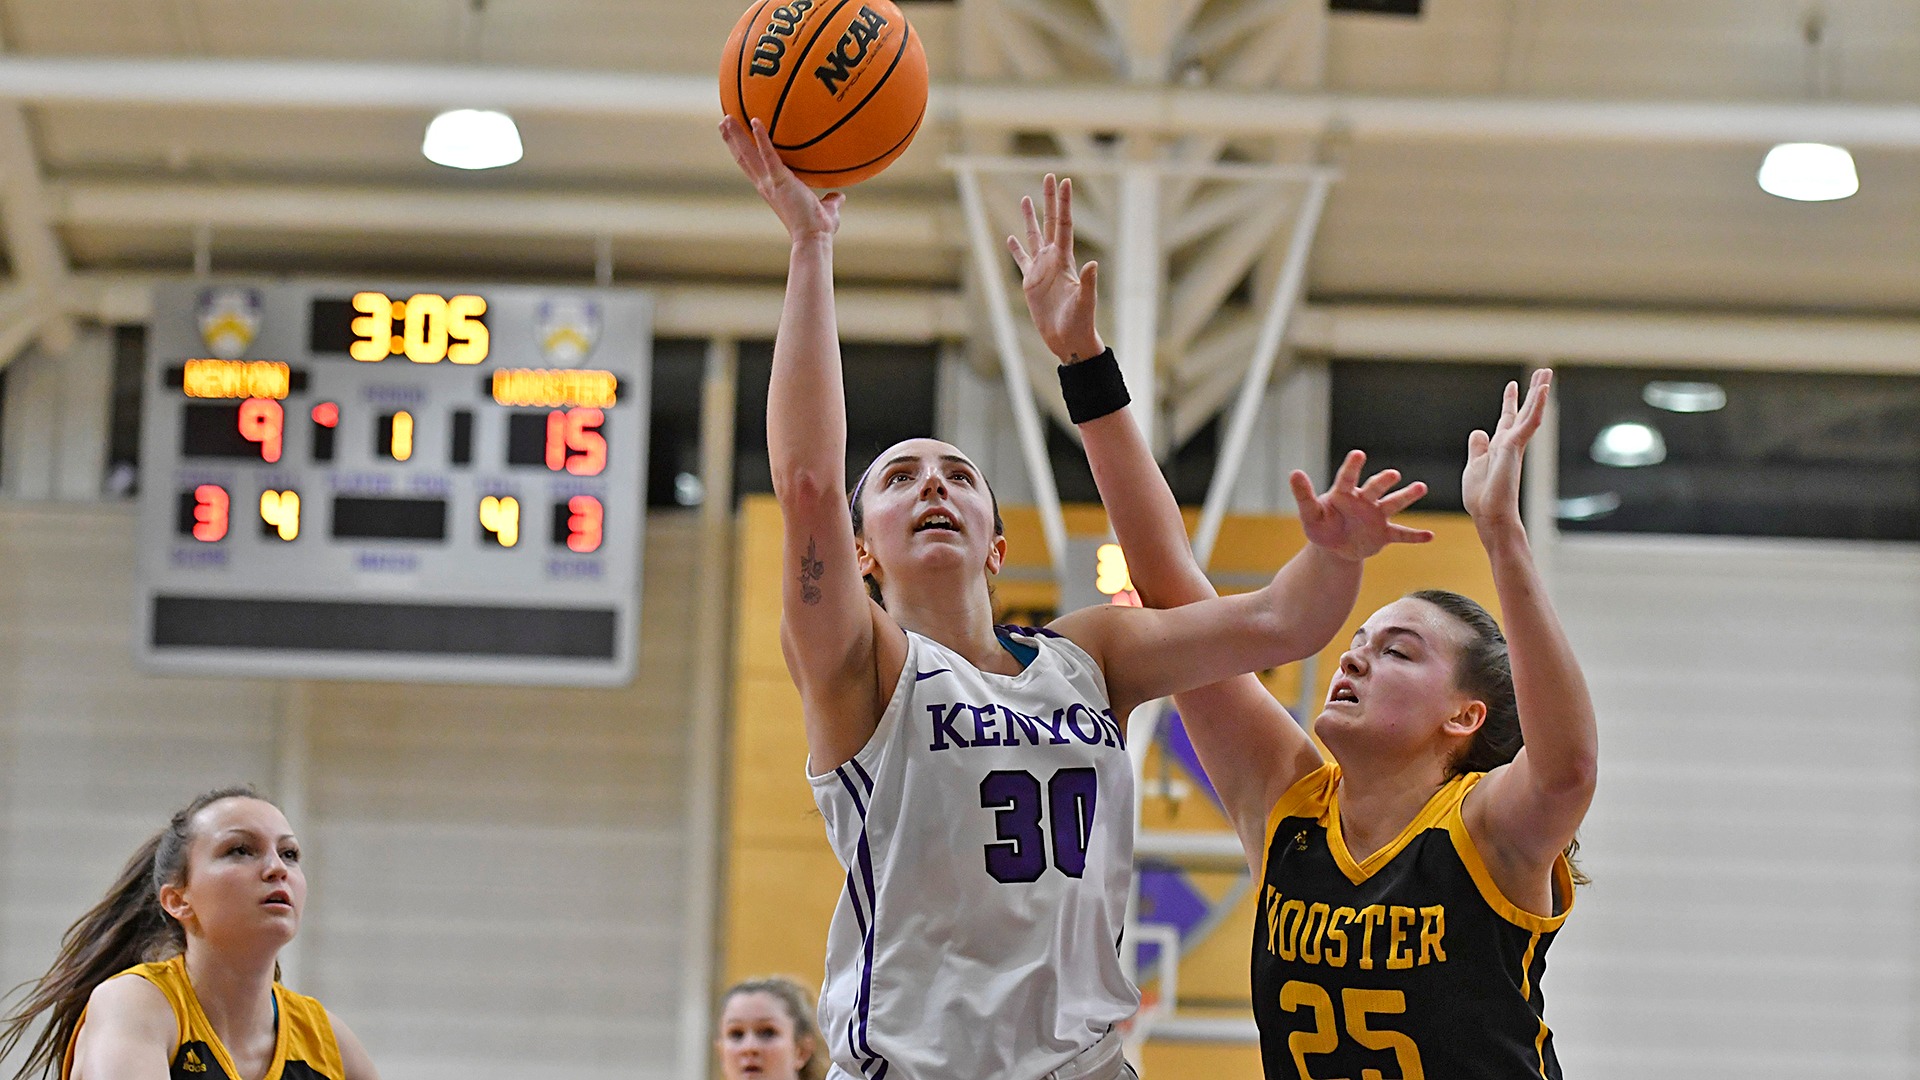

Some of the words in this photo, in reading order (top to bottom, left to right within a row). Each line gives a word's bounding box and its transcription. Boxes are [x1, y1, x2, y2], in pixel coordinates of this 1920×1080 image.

[814, 5, 888, 96] NCAA
[350, 291, 490, 365] 3:05
[239, 398, 284, 463] 9
[391, 411, 414, 461] 1
[545, 407, 608, 477] 15
[192, 484, 231, 542] 3
[260, 489, 300, 541] 4
[479, 495, 520, 548] 4
[566, 495, 604, 553] 3
[926, 702, 1126, 752] KENYON
[979, 766, 1098, 884] 30
[1279, 979, 1426, 1080] 25
